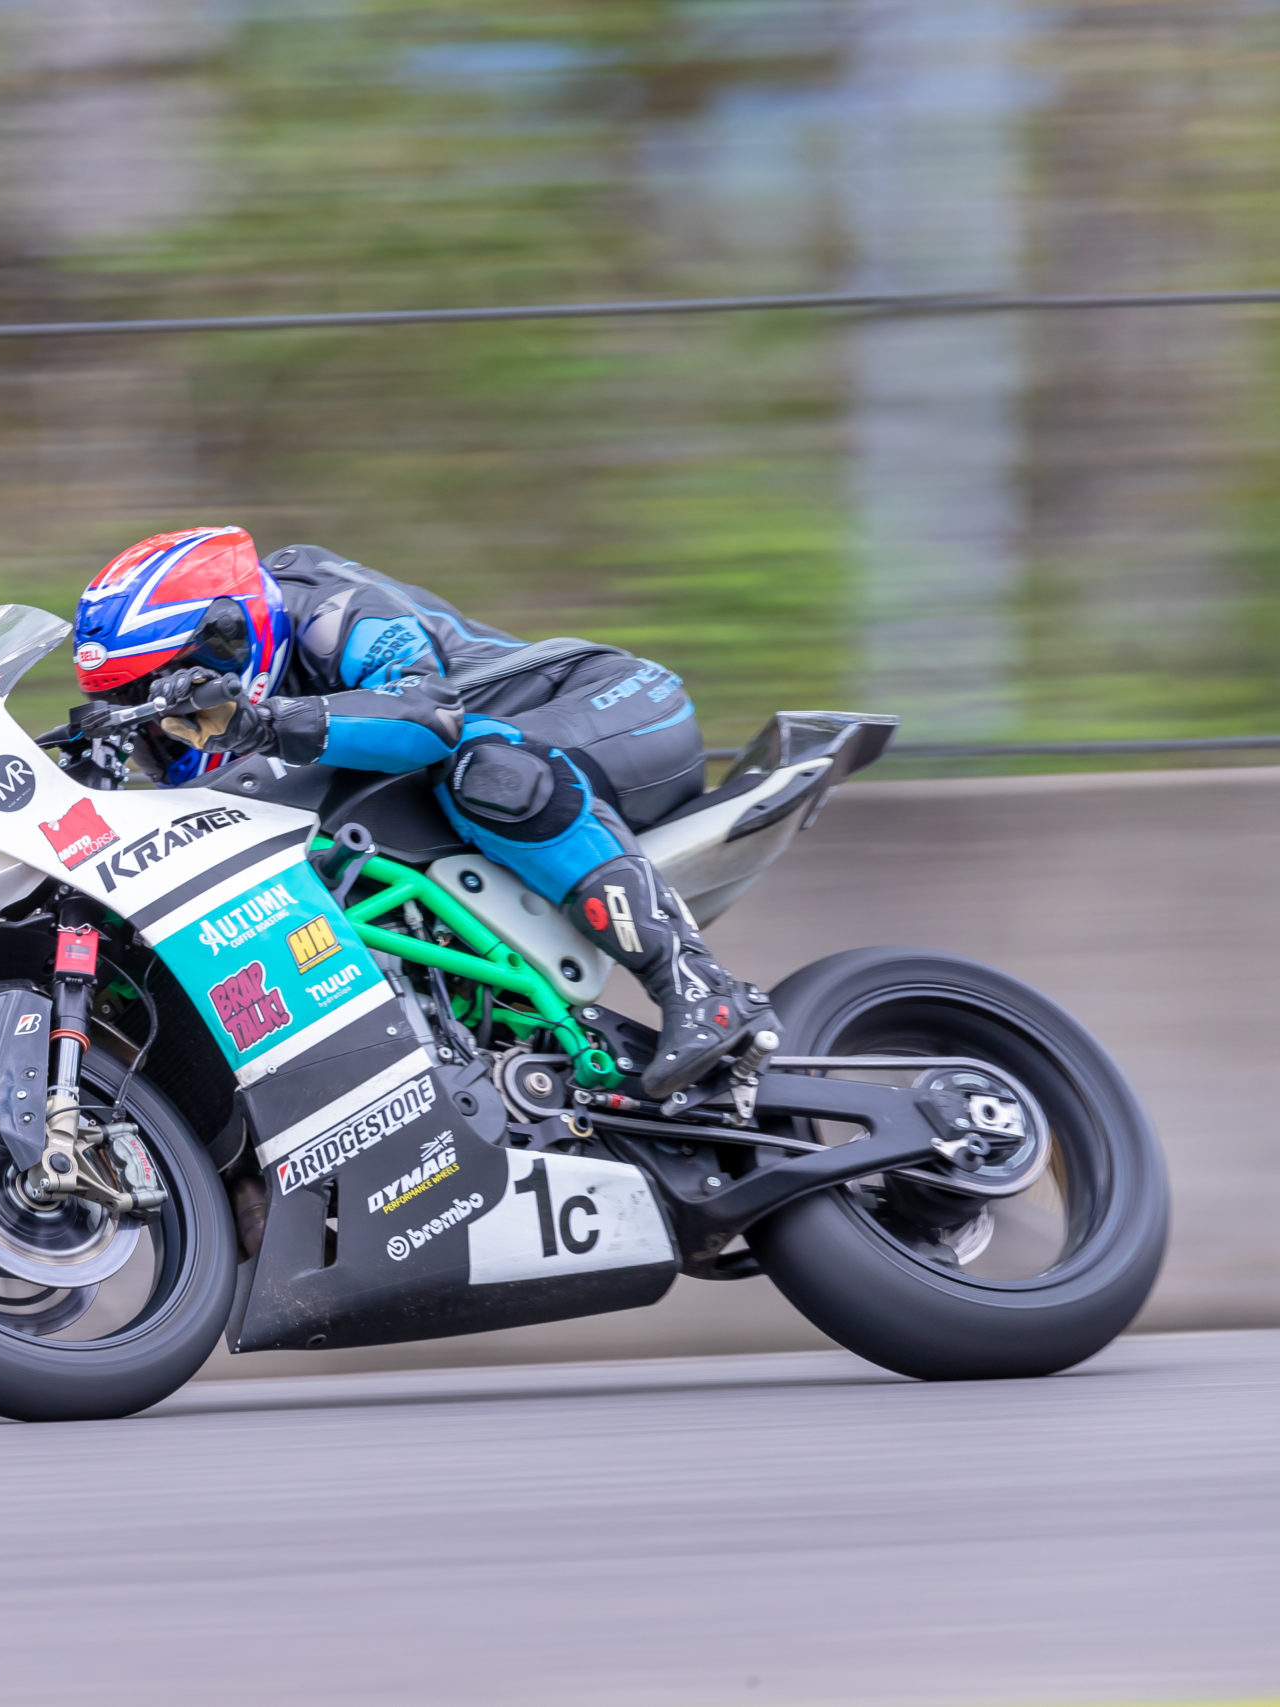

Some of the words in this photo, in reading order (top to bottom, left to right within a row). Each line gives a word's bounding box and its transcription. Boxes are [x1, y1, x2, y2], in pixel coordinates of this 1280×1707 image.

[79, 649, 102, 662] BELL
[58, 834, 92, 861] MOTO
[83, 829, 119, 857] CORSA
[95, 806, 252, 894] KRAMER
[198, 883, 299, 957] AUTUMN
[229, 927, 258, 949] COFFEE
[288, 916, 337, 966] HH
[208, 961, 266, 1024] BRAP
[304, 963, 363, 1002] nuun
[222, 987, 291, 1053] TALK!
[280, 1076, 435, 1194] BRIDGESTONE
[367, 1146, 457, 1214] DYMAG
[382, 1178, 434, 1215] PERFORMANCE
[429, 1161, 461, 1185] WHEELS
[405, 1192, 484, 1249] brembo
